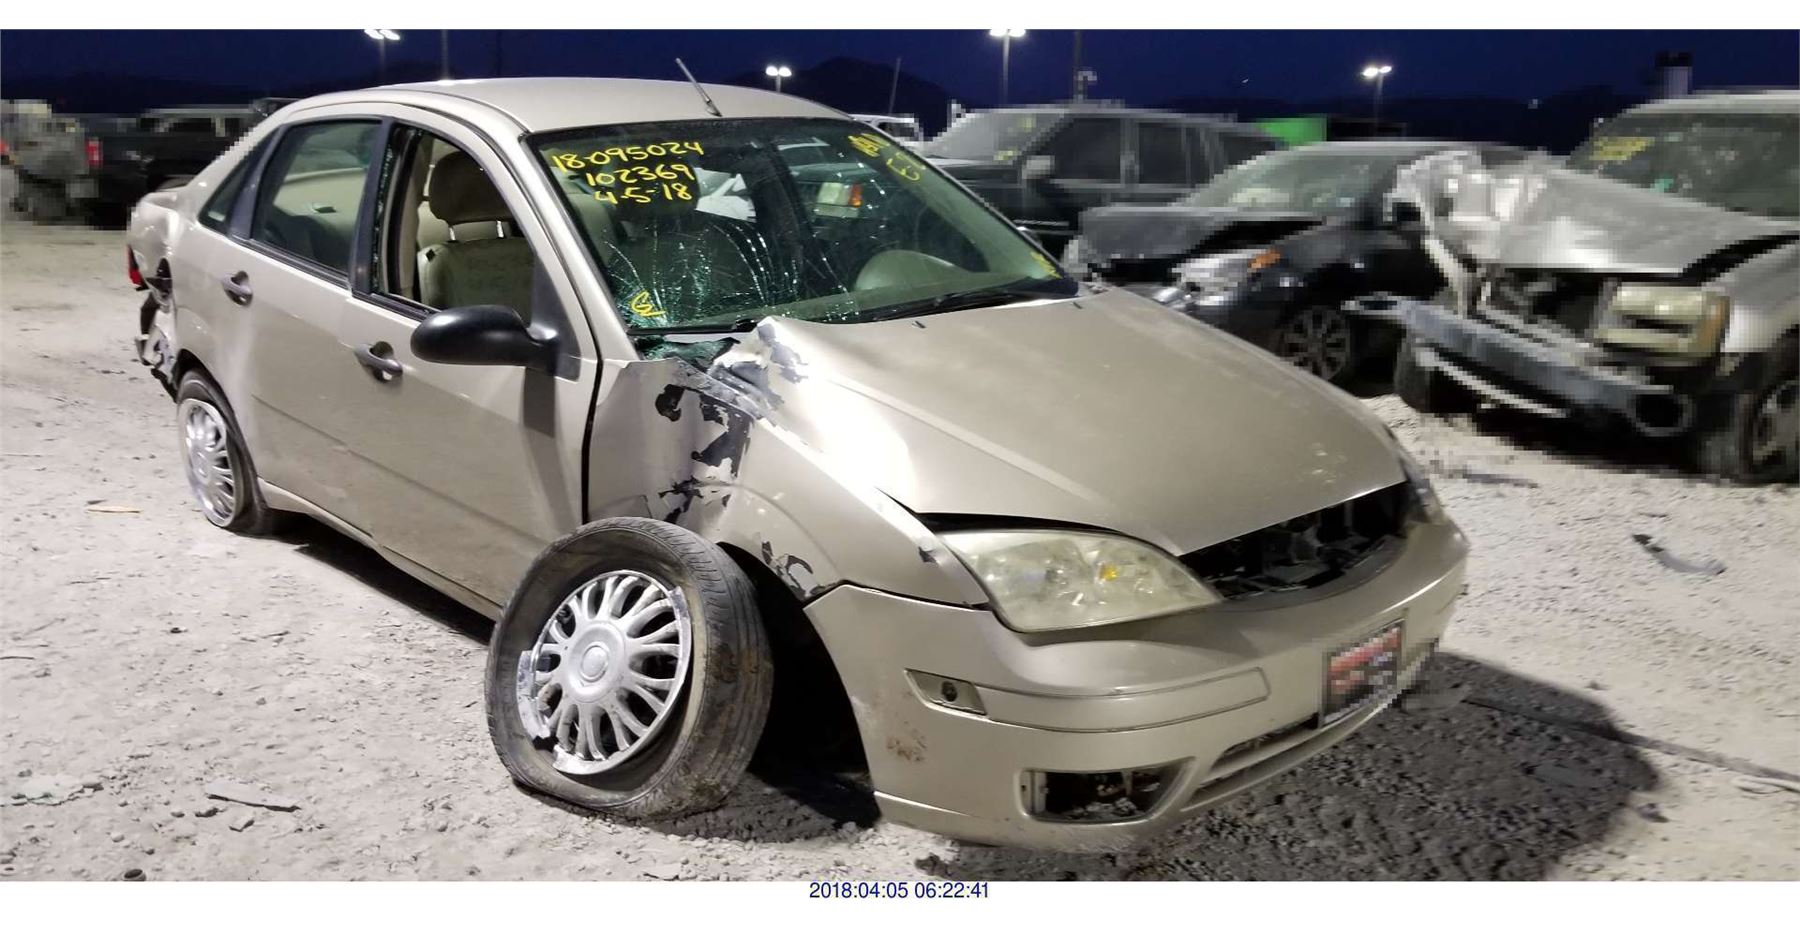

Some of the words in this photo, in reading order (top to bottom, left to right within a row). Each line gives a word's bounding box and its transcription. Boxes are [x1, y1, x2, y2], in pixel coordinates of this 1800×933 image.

[552, 142, 704, 173] 18-095024
[586, 163, 695, 187] 102369
[594, 182, 693, 205] 4-5-18
